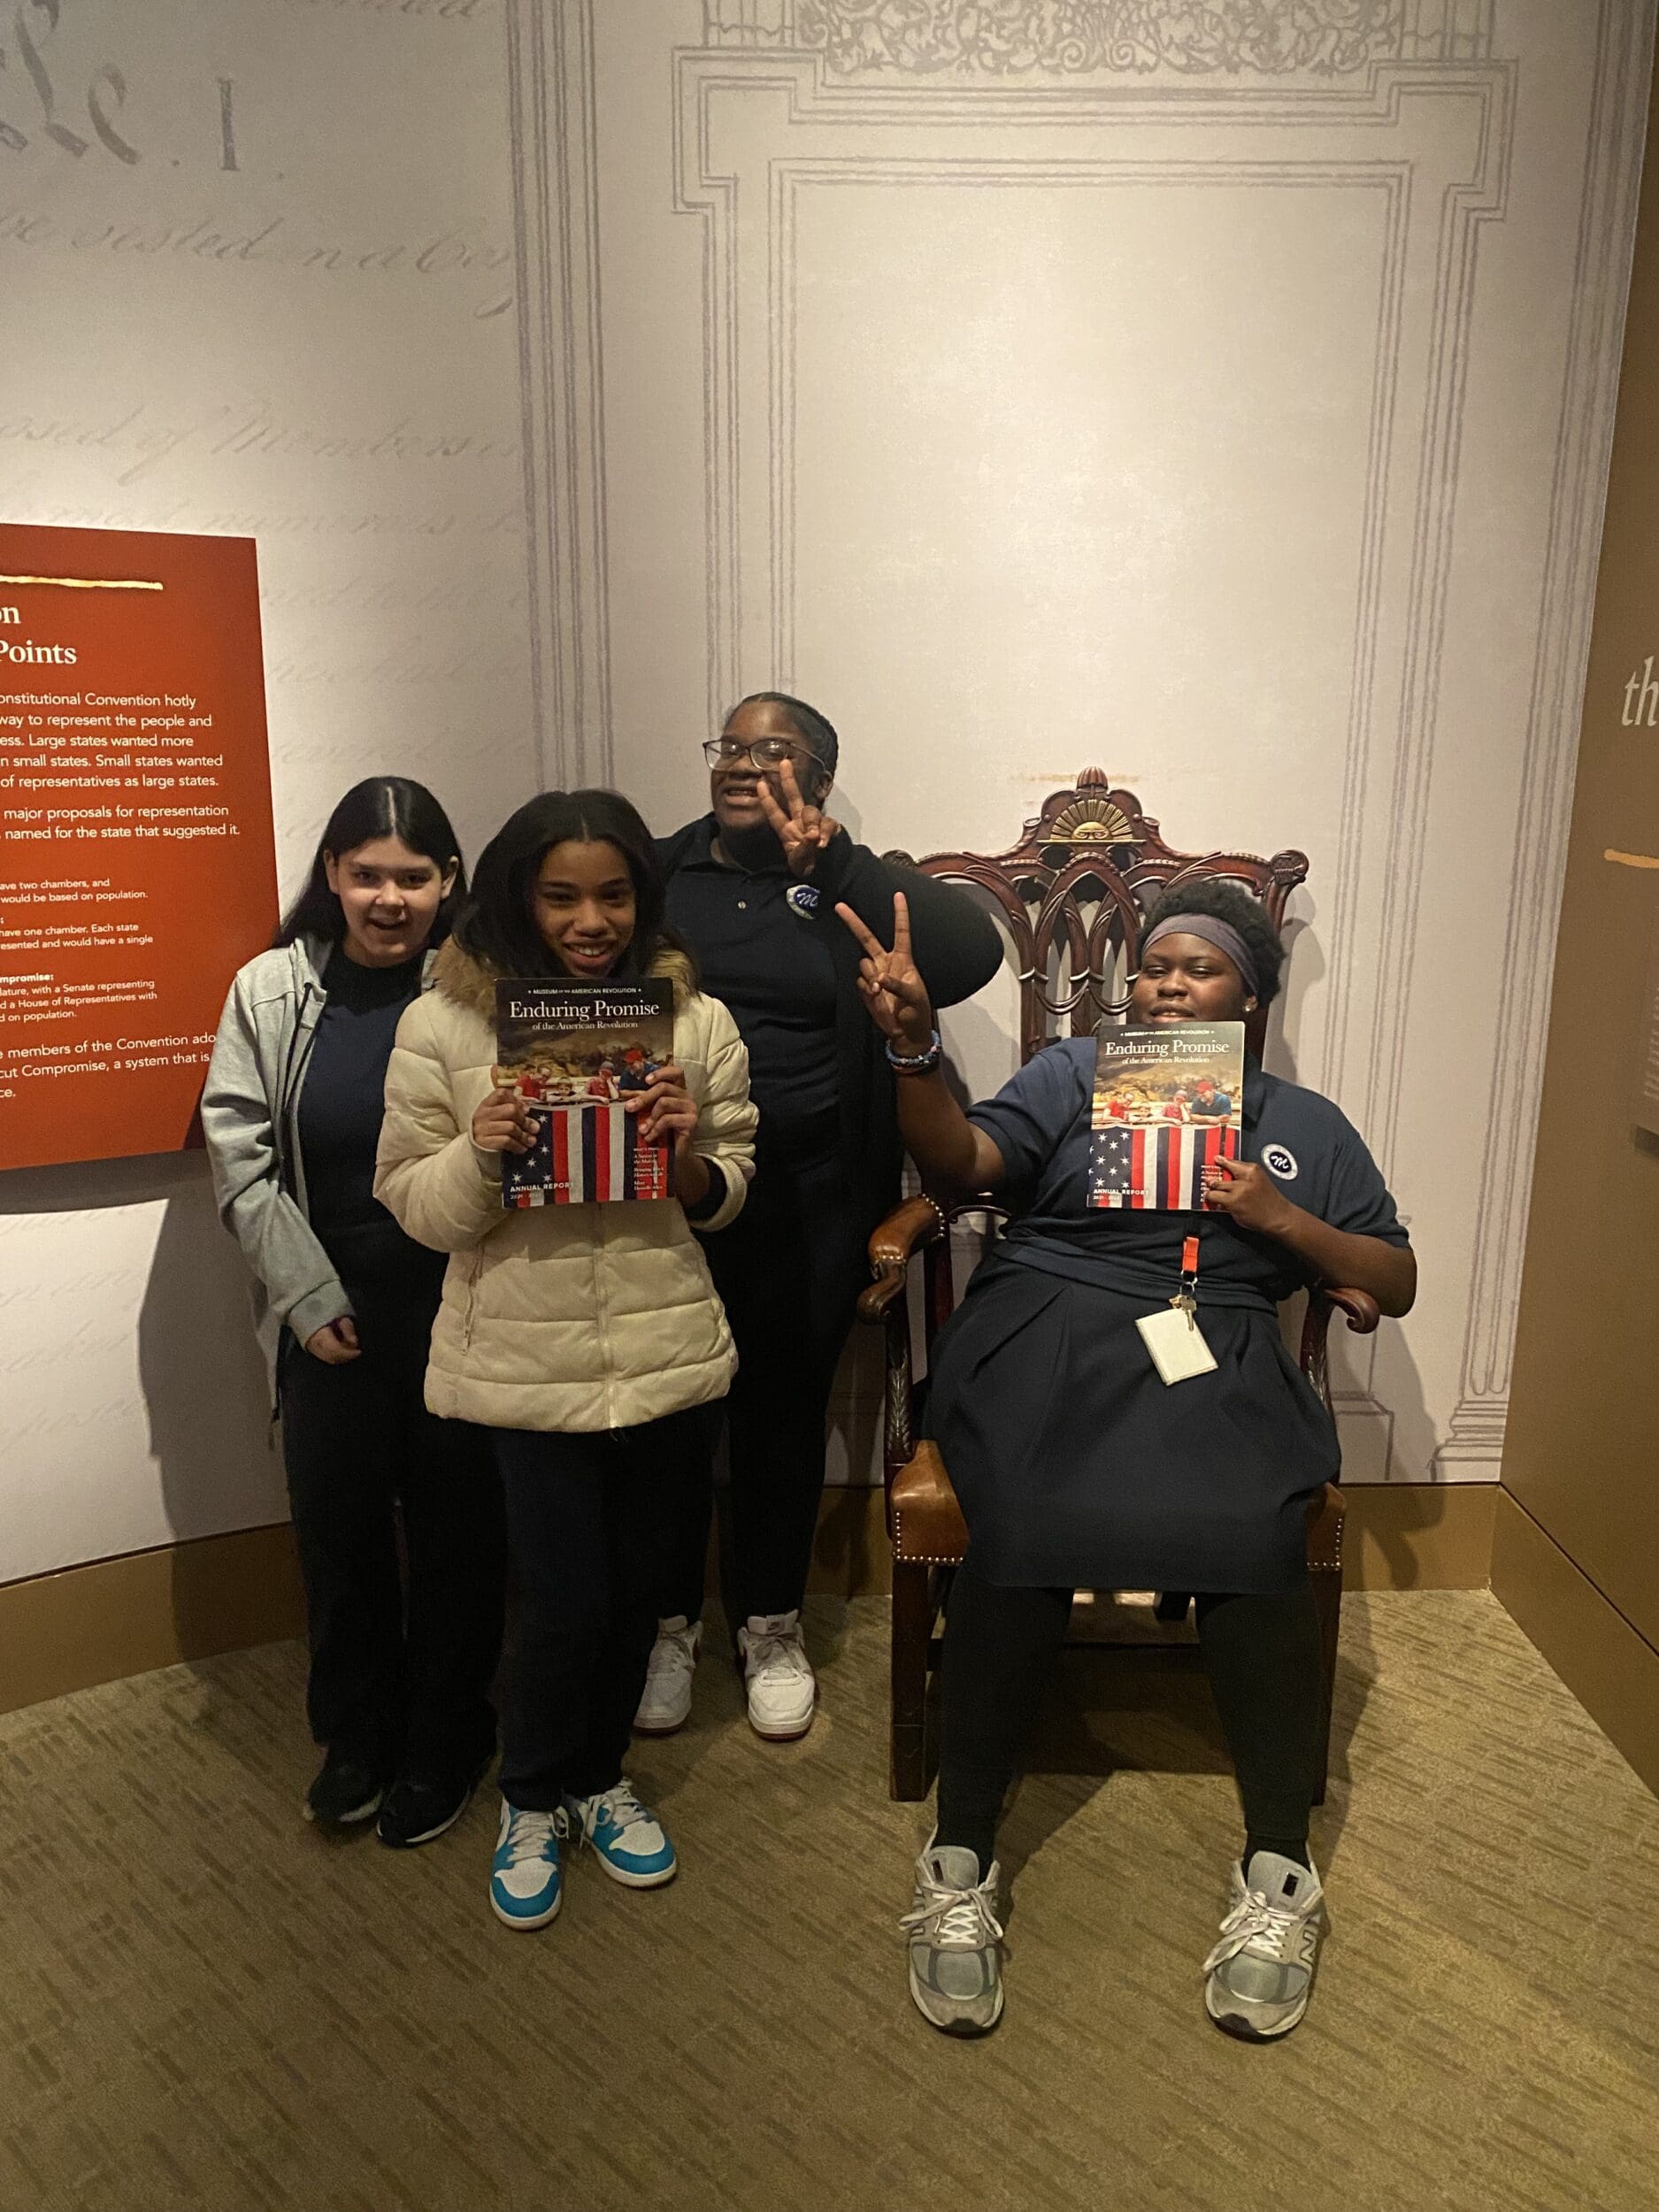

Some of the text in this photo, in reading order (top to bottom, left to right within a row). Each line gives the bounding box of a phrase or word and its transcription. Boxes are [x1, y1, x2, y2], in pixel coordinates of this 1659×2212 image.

[0, 605, 21, 624] n
[1621, 655, 1659, 726] th
[85, 692, 161, 706] Convention
[165, 694, 196, 710] hotly
[28, 715, 42, 725] to
[47, 716, 111, 729] represent
[115, 714, 136, 726] the
[141, 714, 185, 730] people
[188, 714, 212, 726] and
[29, 733, 66, 749] Large
[70, 735, 107, 746] states
[111, 733, 157, 746] wanted
[161, 737, 194, 746] more
[13, 754, 46, 766] small
[50, 757, 91, 766] states.
[96, 754, 130, 766] Small
[134, 757, 173, 766] states
[176, 754, 223, 766] wanted
[1, 774, 219, 791] of representatives as large states.
[4, 804, 229, 822] major proposals for representation
[5, 823, 240, 839] named for the state that suggested it.
[40, 879, 89, 888] chambers,
[92, 878, 111, 887] and
[1, 893, 31, 902] would
[33, 893, 46, 902] be
[49, 891, 79, 901] based
[96, 889, 149, 902] population.
[45, 926, 88, 935] chamber.
[91, 923, 114, 933] Each
[116, 923, 139, 932] state
[42, 938, 60, 949] and
[62, 936, 91, 947] would
[94, 935, 116, 946] have
[127, 933, 154, 945] single
[31, 984, 51, 995] with
[63, 983, 95, 993] Senate
[97, 979, 155, 992] representing
[18, 999, 50, 1008] House
[52, 996, 62, 1006] of
[64, 993, 136, 1007] Representatives
[138, 991, 157, 1001] with
[23, 1010, 77, 1023] population.
[510, 999, 659, 1021] Enduring Promise
[532, 1019, 638, 1031] of the American Revolution
[8, 1043, 71, 1058] members
[74, 1040, 88, 1053] of
[91, 1039, 112, 1052] the
[116, 1034, 188, 1049] Convention
[1105, 1039, 1230, 1056] Enduring Promise
[21, 1060, 110, 1078] Compromise,
[113, 1060, 121, 1070] a
[125, 1056, 169, 1071] system
[173, 1051, 196, 1064] that
[200, 1050, 210, 1062] is
